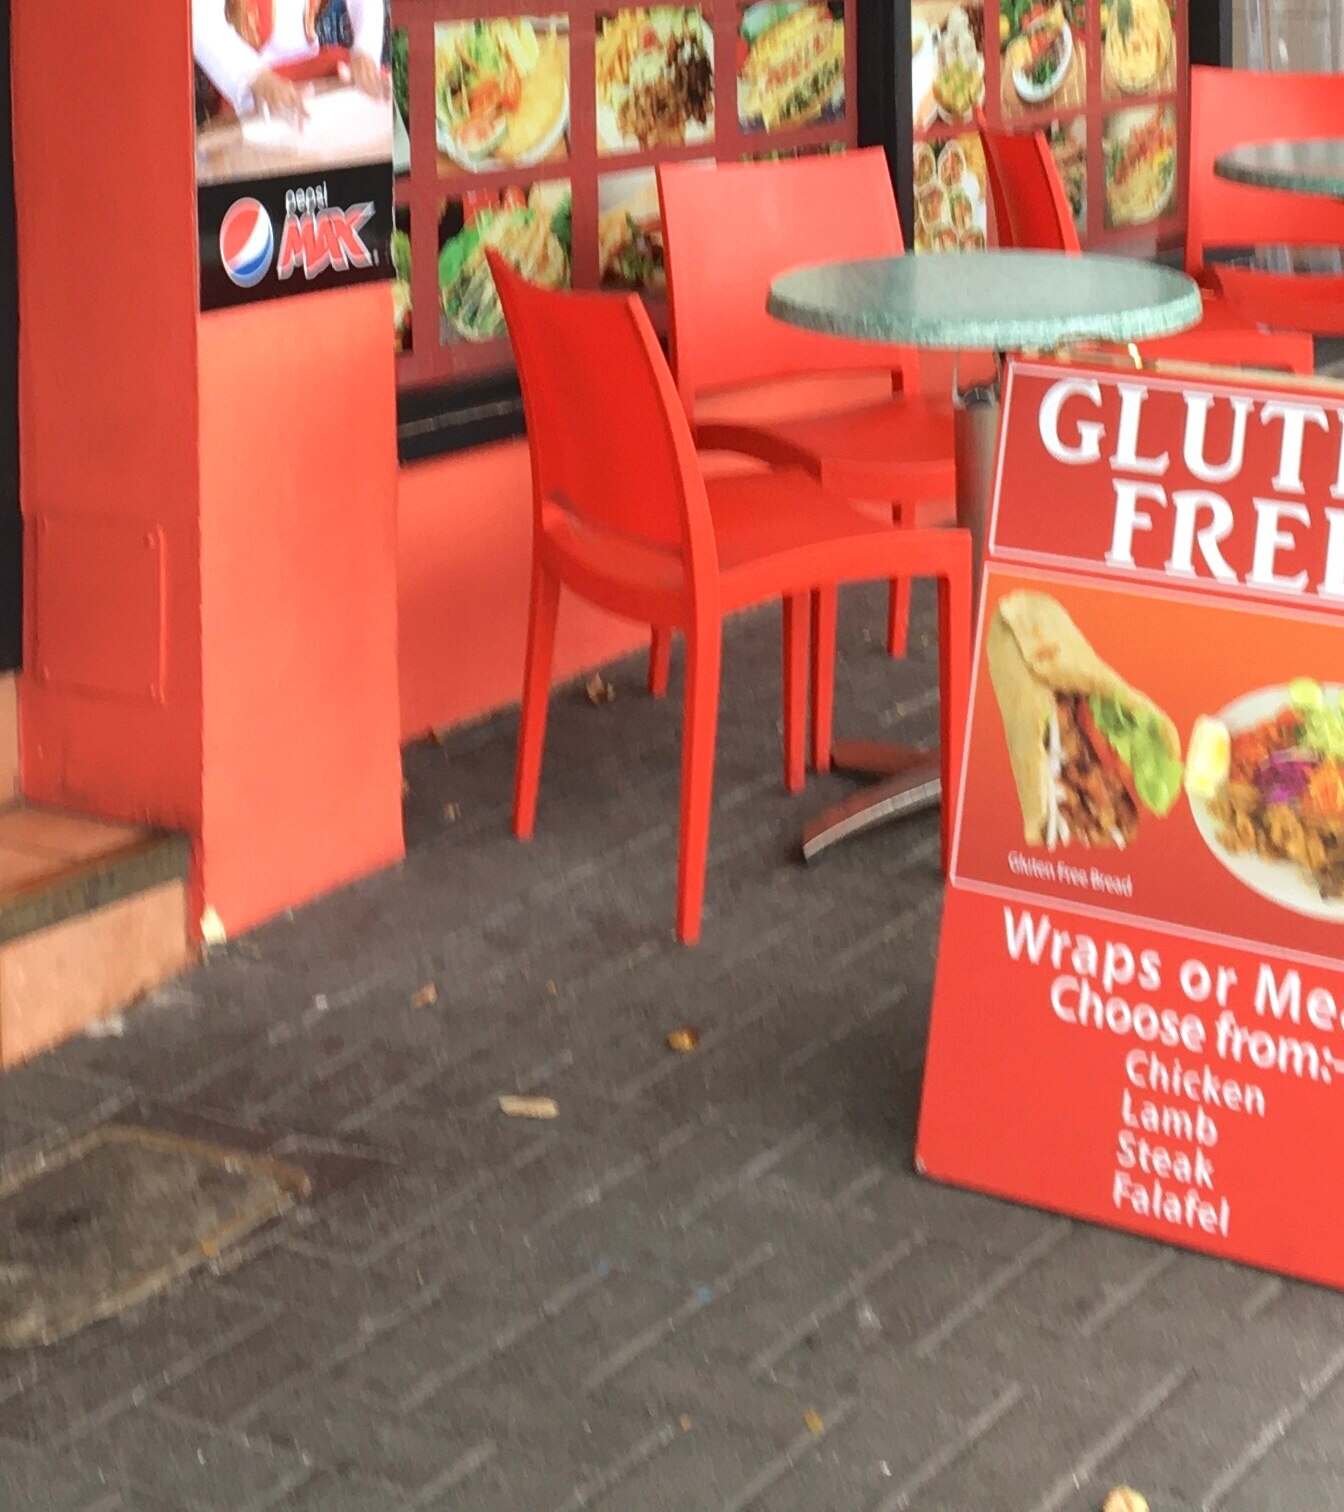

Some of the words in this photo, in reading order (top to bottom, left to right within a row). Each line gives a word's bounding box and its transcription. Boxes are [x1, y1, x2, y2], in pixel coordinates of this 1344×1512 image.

[277, 201, 376, 280] MAX
[1003, 906, 1161, 993] Wraps
[1179, 959, 1237, 1006] or
[1050, 974, 1206, 1053] Choose
[1125, 1048, 1265, 1117] Chicken
[1121, 1088, 1218, 1148] Lamb
[1117, 1129, 1214, 1189] Steak
[1112, 1169, 1230, 1237] Falafel
